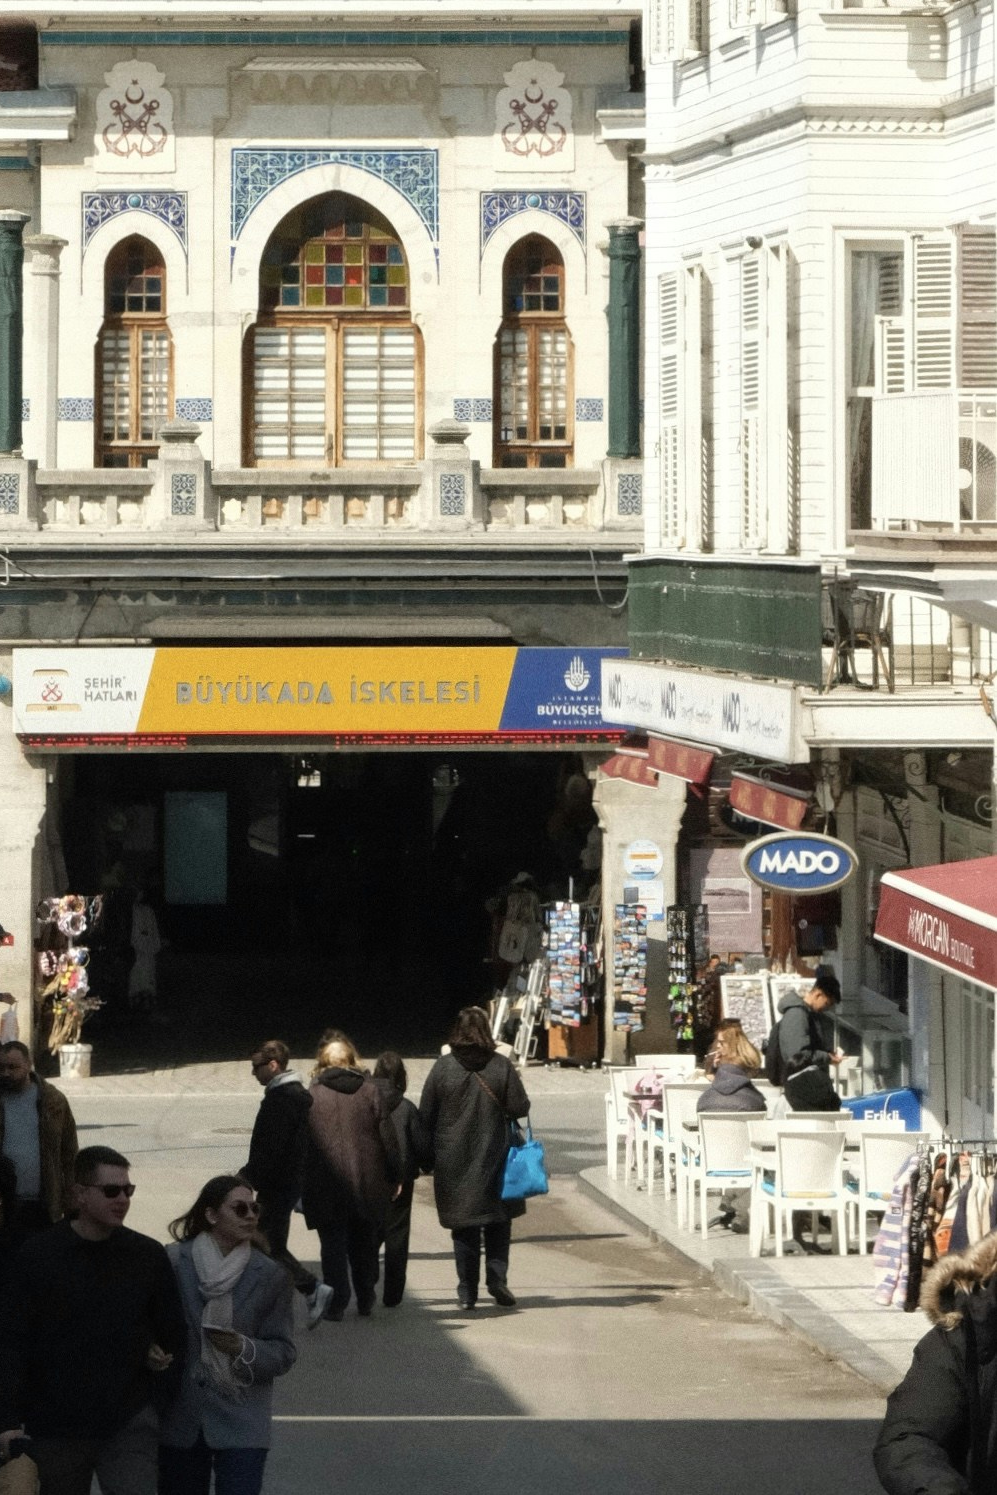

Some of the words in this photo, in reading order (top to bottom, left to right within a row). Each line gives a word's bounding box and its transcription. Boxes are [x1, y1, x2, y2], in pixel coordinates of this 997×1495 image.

[84, 675, 122, 690] ŞEHİR
[176, 674, 335, 705] BÜYÜKADA
[350, 674, 481, 704] İSKELESİ
[84, 690, 138, 702] HATLARI
[537, 702, 602, 718] BÜYÜKŞEH
[759, 849, 840, 875] MADO
